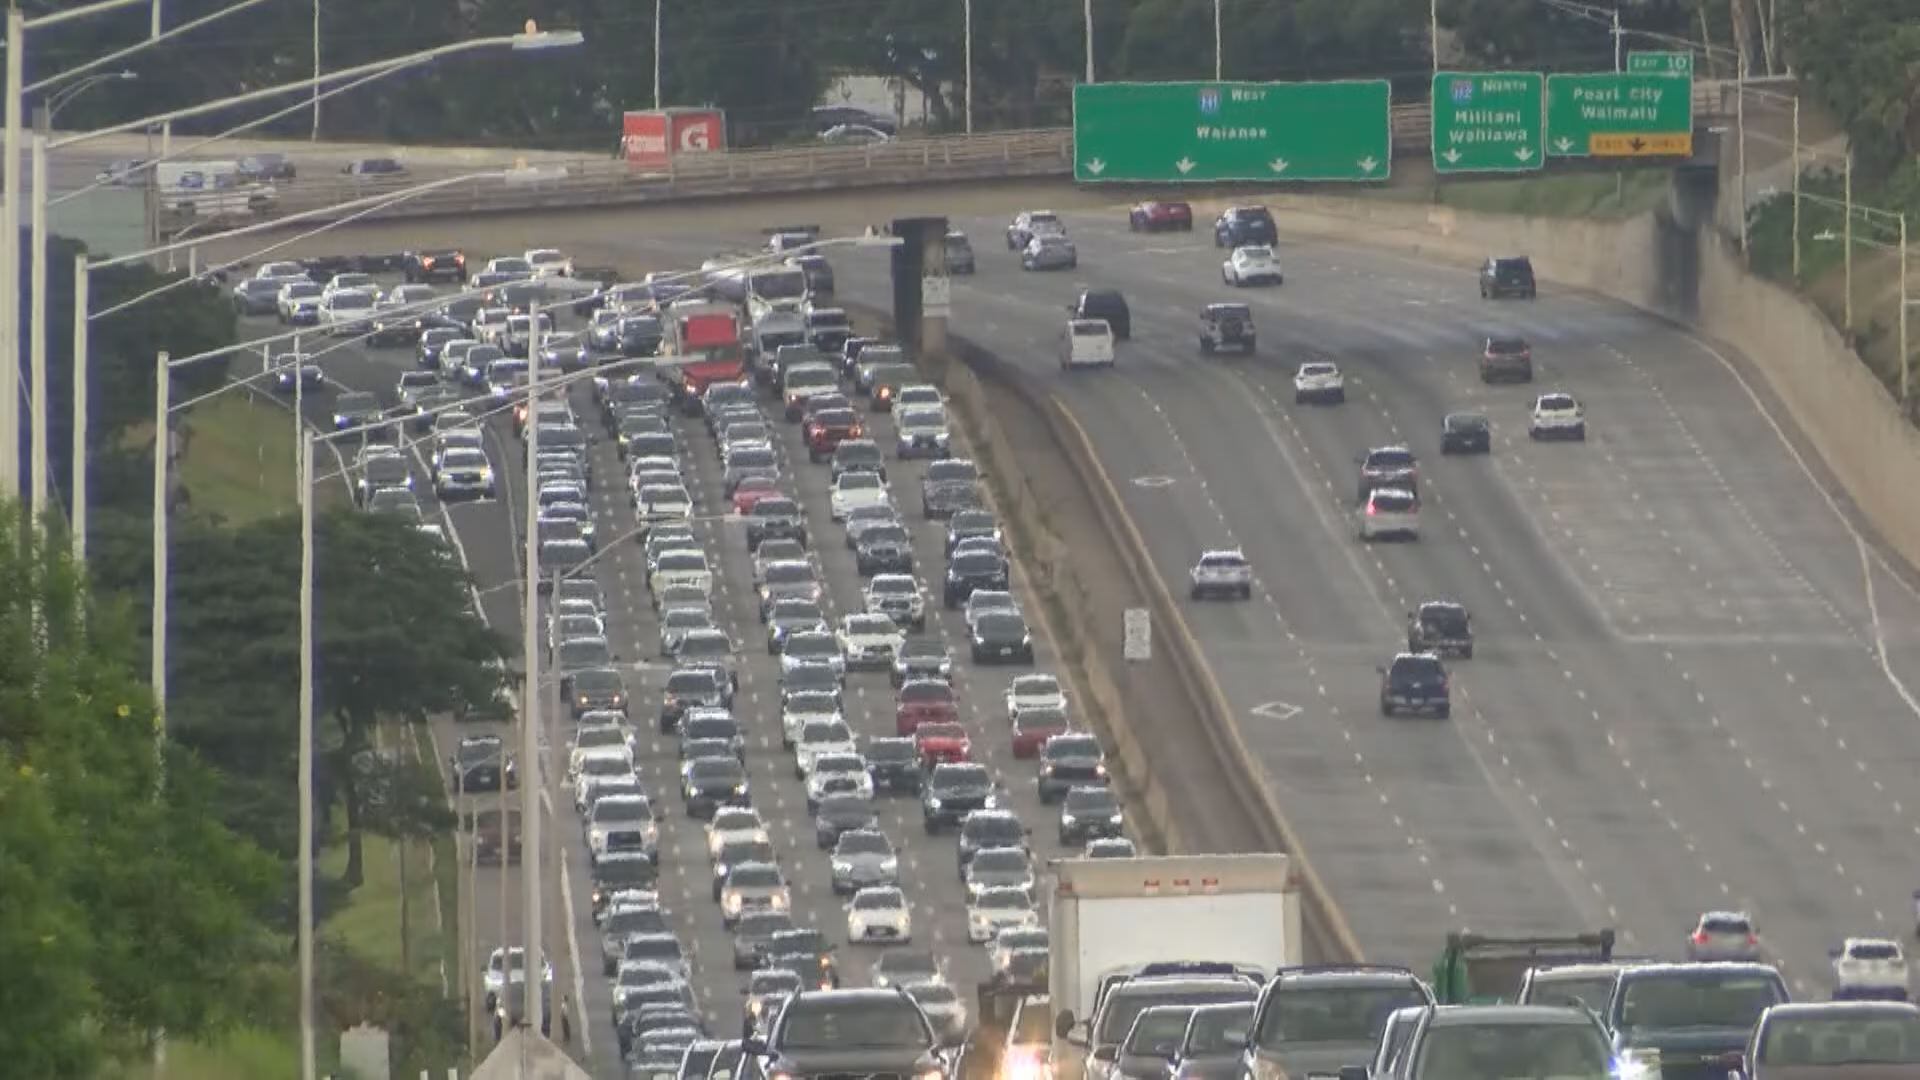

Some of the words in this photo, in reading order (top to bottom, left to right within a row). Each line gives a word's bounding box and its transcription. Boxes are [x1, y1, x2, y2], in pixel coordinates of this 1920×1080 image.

[1667, 54, 1687, 70] 10
[1574, 86, 1619, 101] Pearl
[1629, 87, 1663, 103] City
[1196, 126, 1267, 140] Waianae
[1449, 129, 1527, 144] Wahiawa
